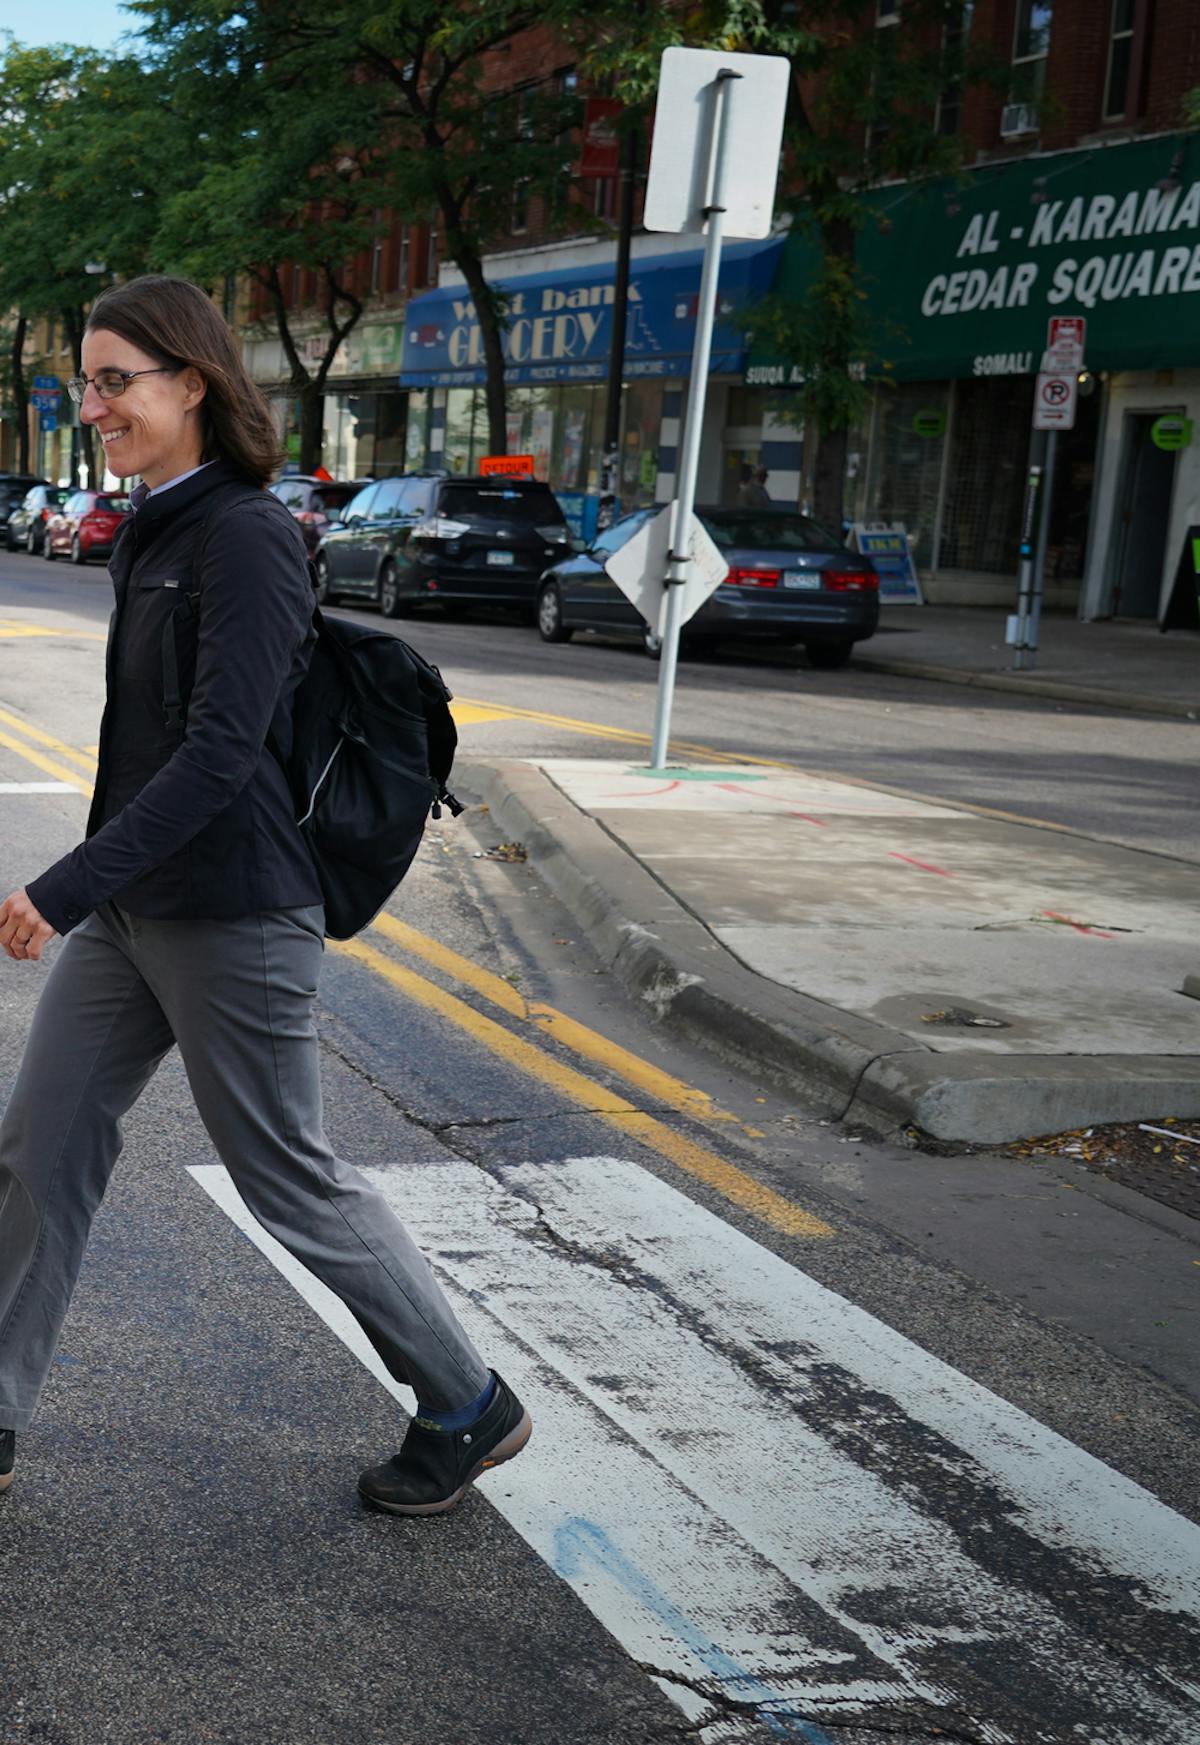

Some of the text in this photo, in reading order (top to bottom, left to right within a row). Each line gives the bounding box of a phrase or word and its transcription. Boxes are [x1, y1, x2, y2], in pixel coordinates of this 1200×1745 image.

[956, 209, 1000, 258] AL
[1027, 181, 1200, 248] KARAMA
[920, 244, 1200, 317] CEDAR SQUARE
[452, 292, 526, 321] Wst
[448, 311, 605, 368] GRCERY
[745, 365, 785, 385] SUUQA
[972, 350, 1033, 376] SOMALI
